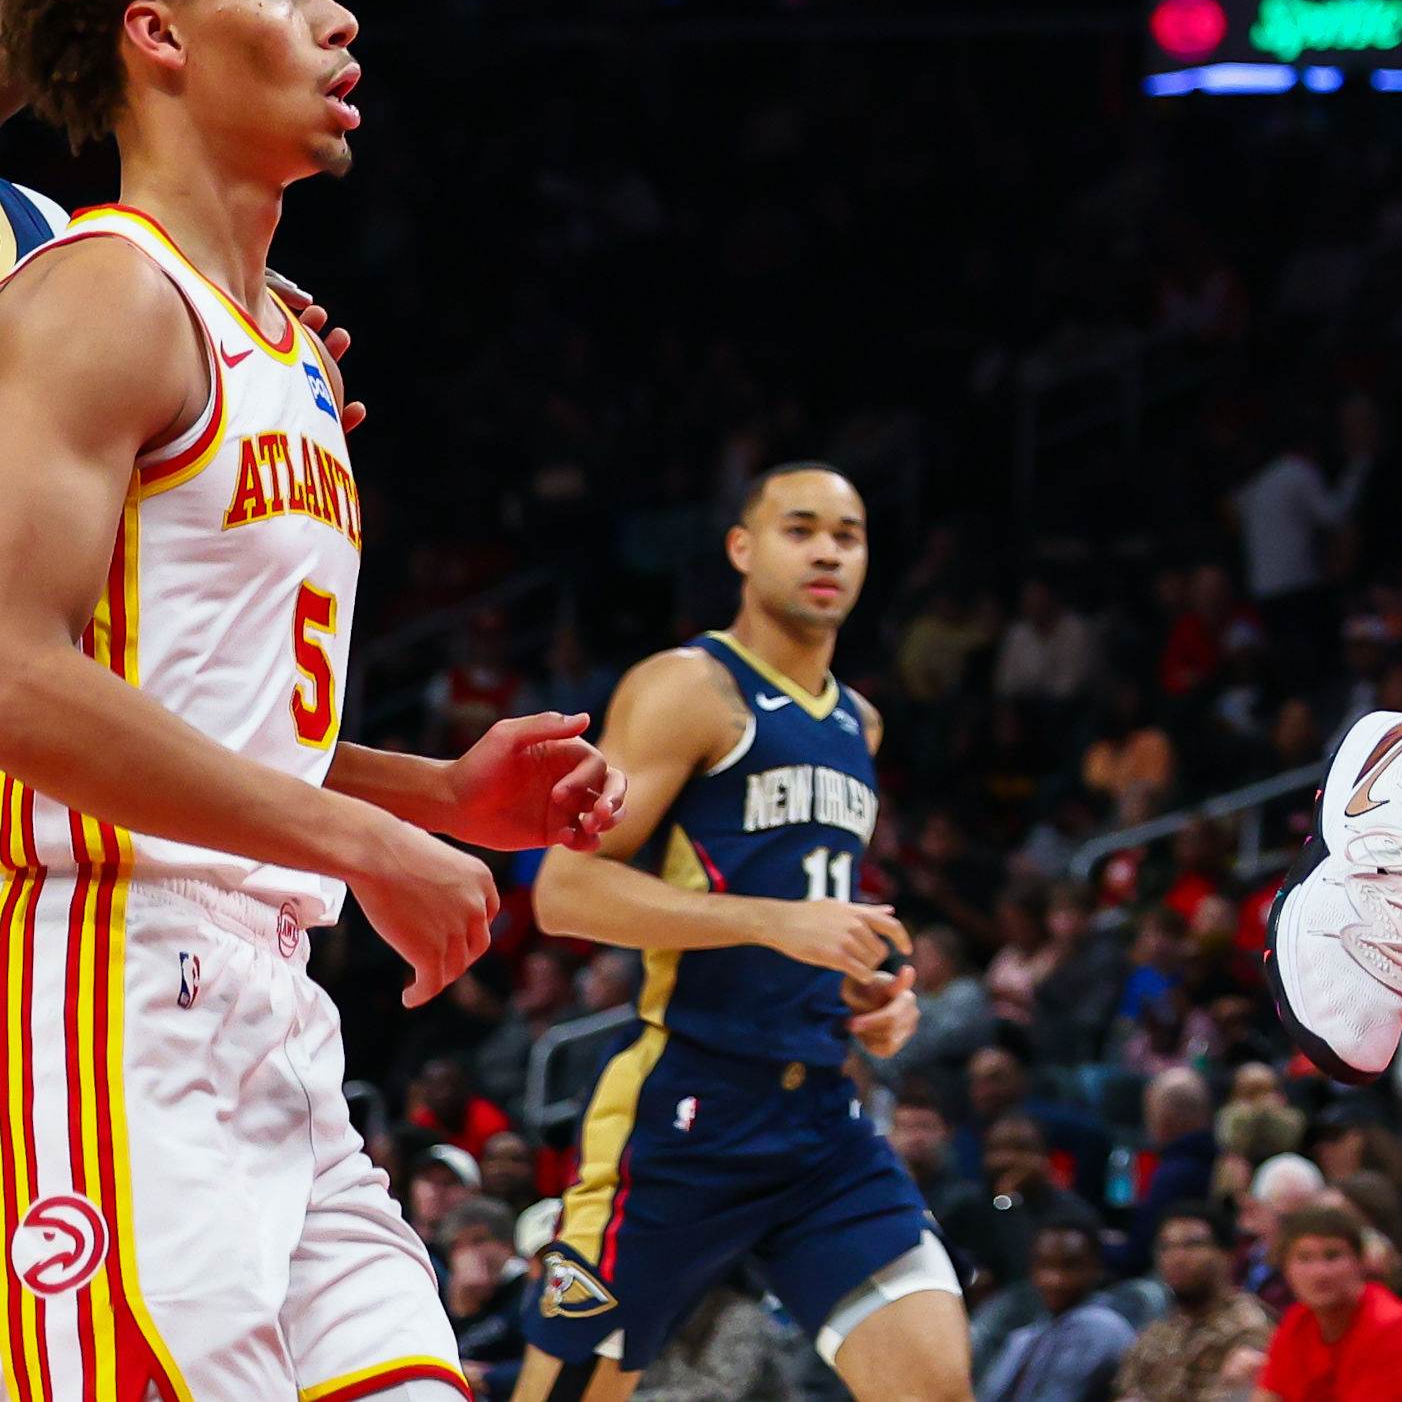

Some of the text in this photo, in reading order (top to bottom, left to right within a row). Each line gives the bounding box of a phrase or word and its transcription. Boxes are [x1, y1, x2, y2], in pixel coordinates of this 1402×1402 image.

[222, 430, 362, 552] ATLANT
[290, 579, 338, 750] 5
[743, 764, 813, 833] NEW
[803, 846, 853, 903] 11
